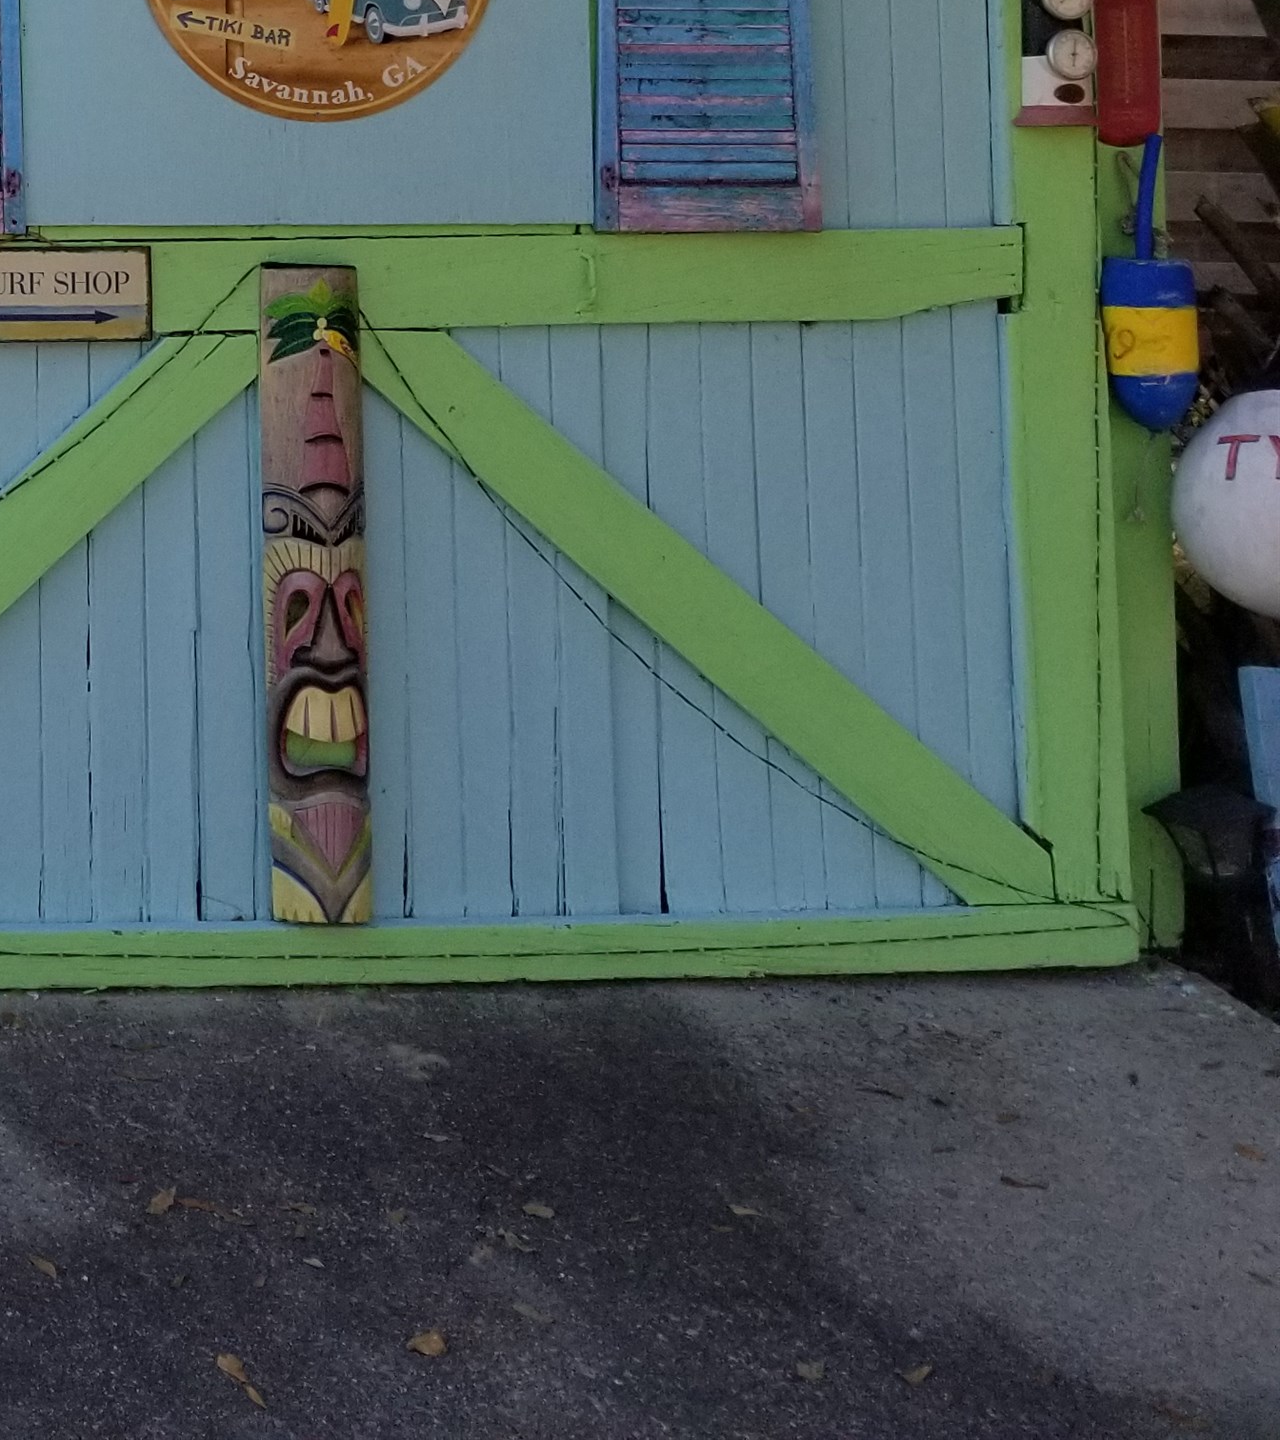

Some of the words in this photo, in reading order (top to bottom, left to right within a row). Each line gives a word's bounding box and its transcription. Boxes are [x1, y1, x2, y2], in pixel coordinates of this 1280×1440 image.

[205, 16, 243, 35] TIKI
[250, 24, 292, 47] BAR
[228, 56, 374, 105] Savannah,
[382, 56, 427, 88] GA
[53, 270, 130, 296] SHOP
